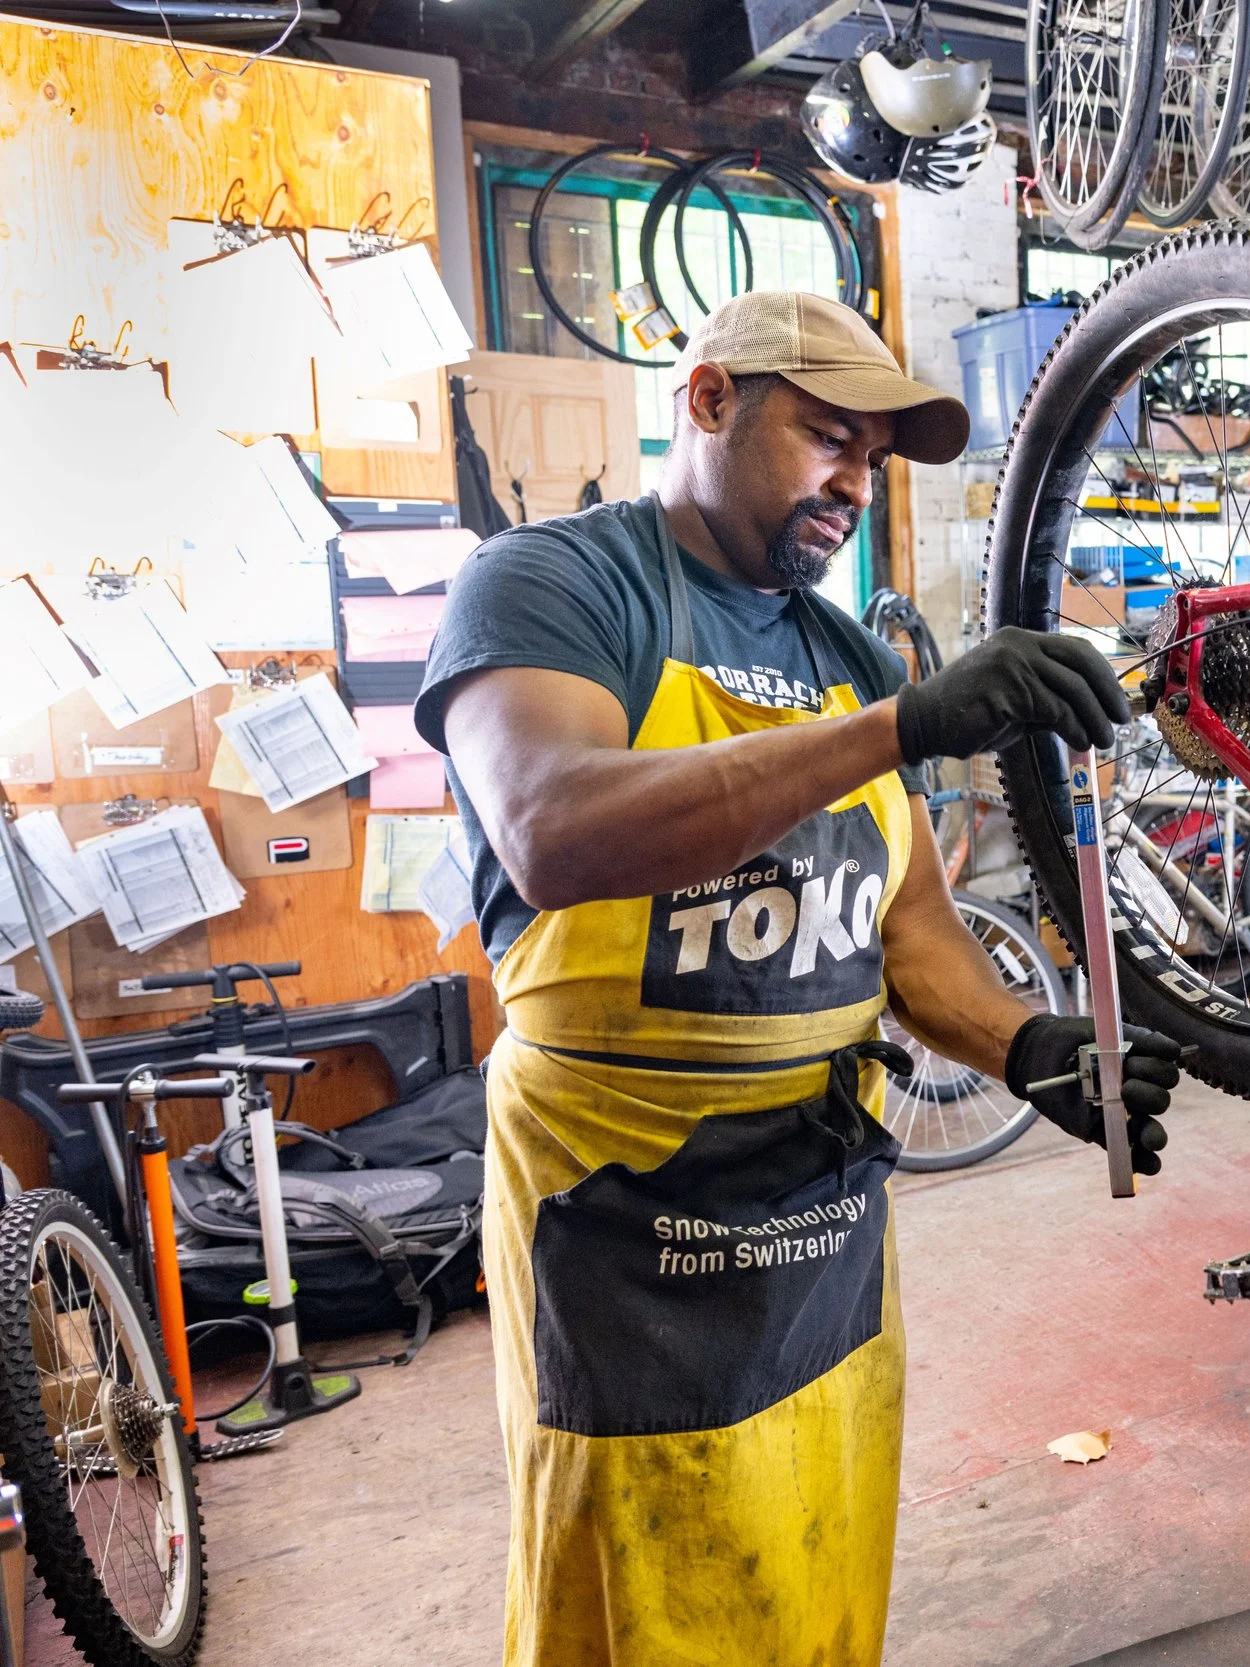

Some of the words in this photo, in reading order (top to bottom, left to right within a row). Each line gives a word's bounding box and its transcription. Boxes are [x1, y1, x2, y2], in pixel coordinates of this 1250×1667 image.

[672, 864, 780, 902] Powered
[792, 855, 815, 878] by
[353, 1177, 430, 1199] Atlas
[654, 1216, 730, 1241] Snow
[659, 1247, 725, 1275] from
[735, 1228, 852, 1269] Switzerla
